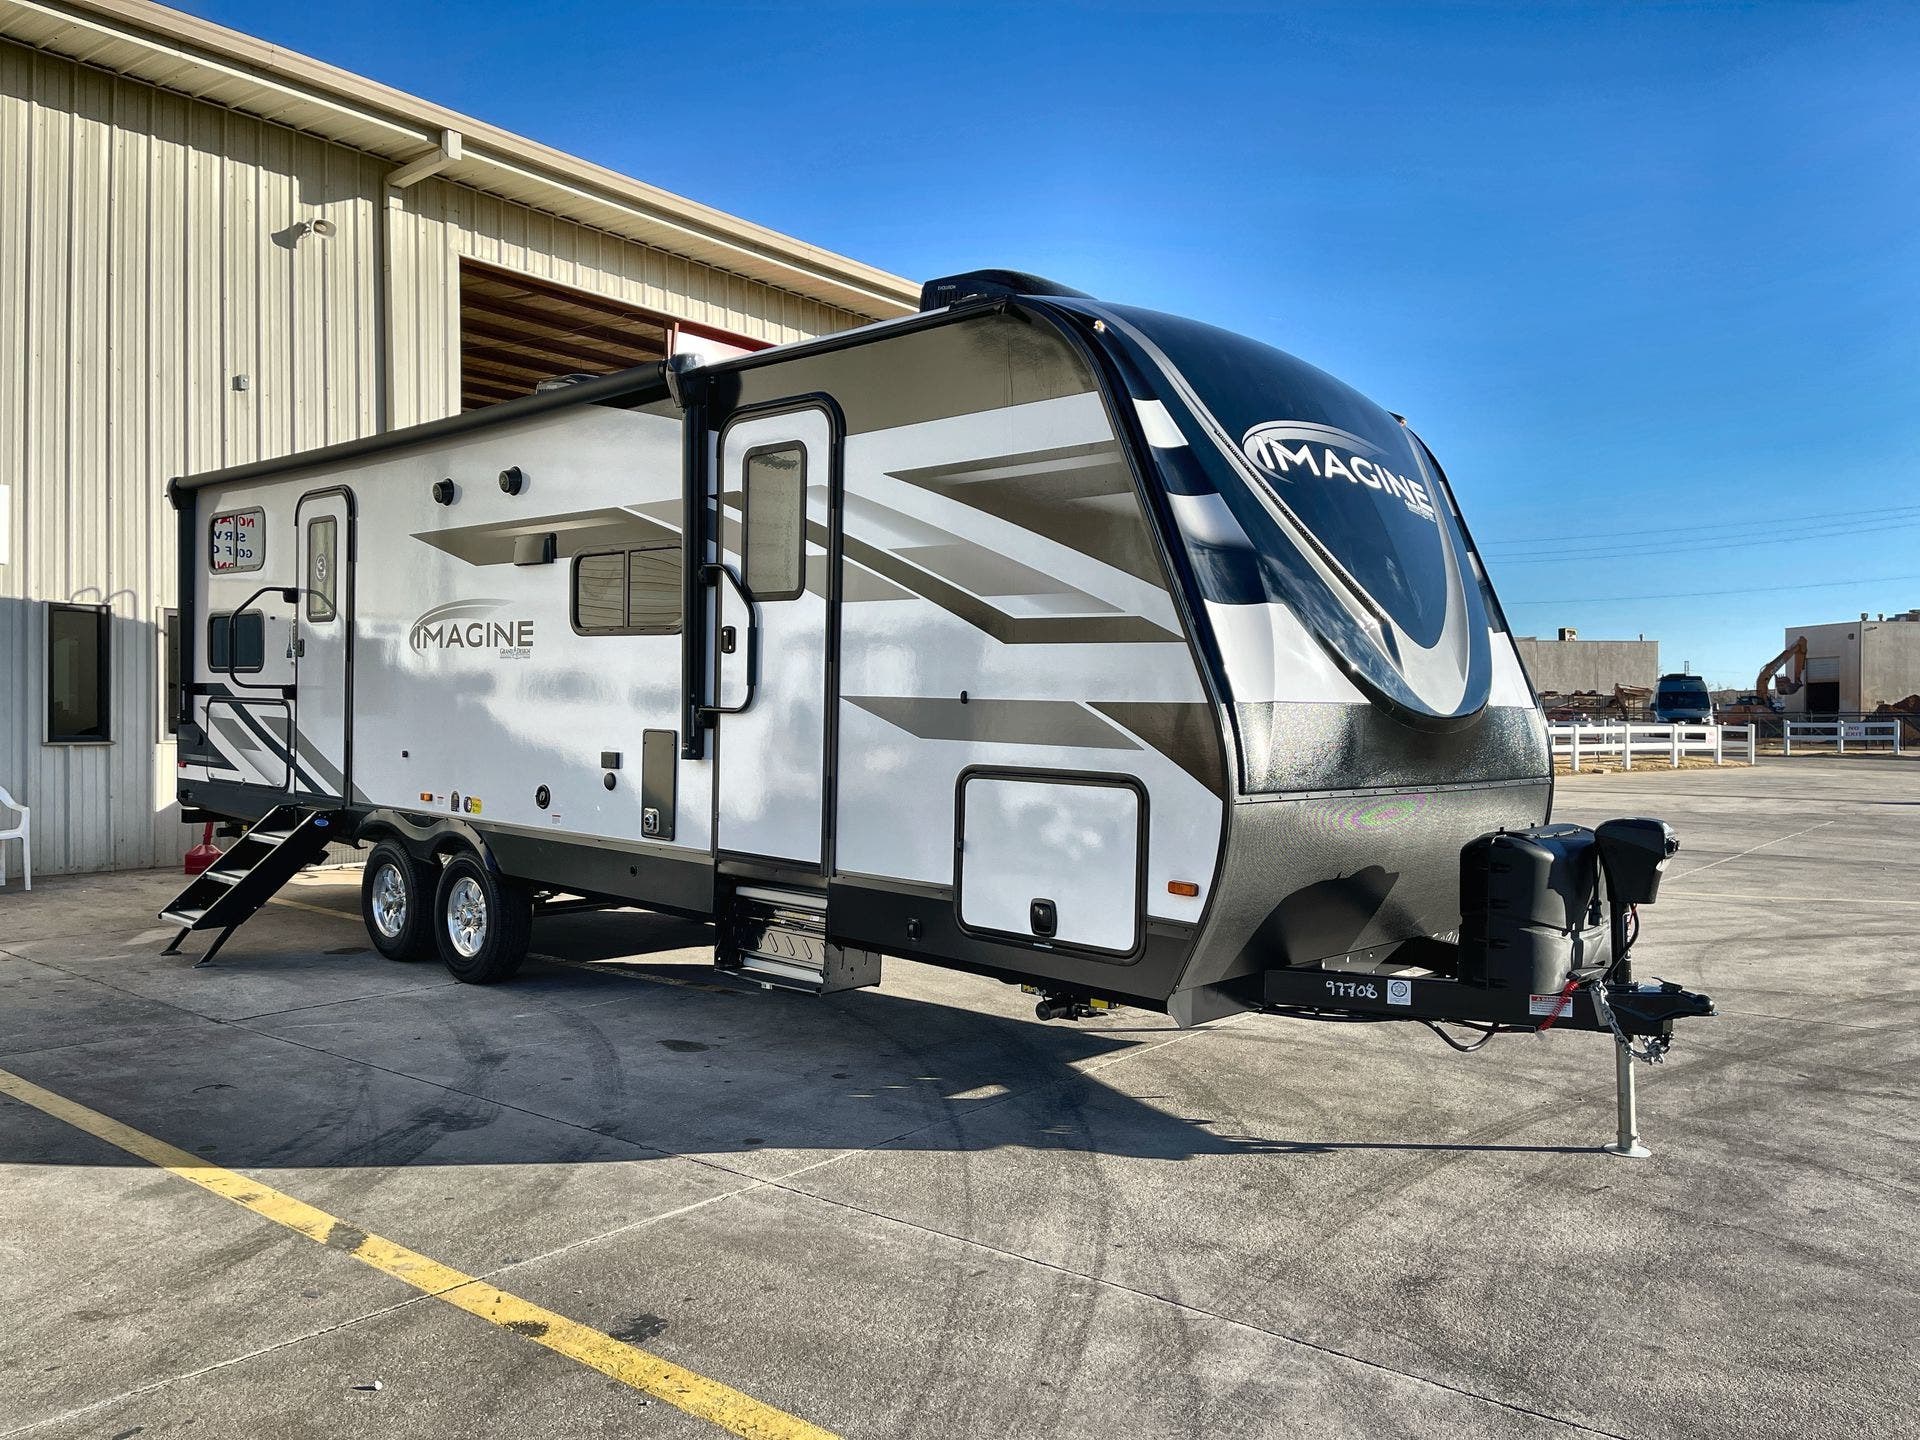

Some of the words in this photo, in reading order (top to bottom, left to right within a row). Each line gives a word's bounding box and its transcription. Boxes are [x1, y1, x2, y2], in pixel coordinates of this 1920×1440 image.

[1253, 434, 1435, 514] IMAGINE
[416, 620, 534, 649] IMAGINE
[1325, 980, 1378, 999] 97708
